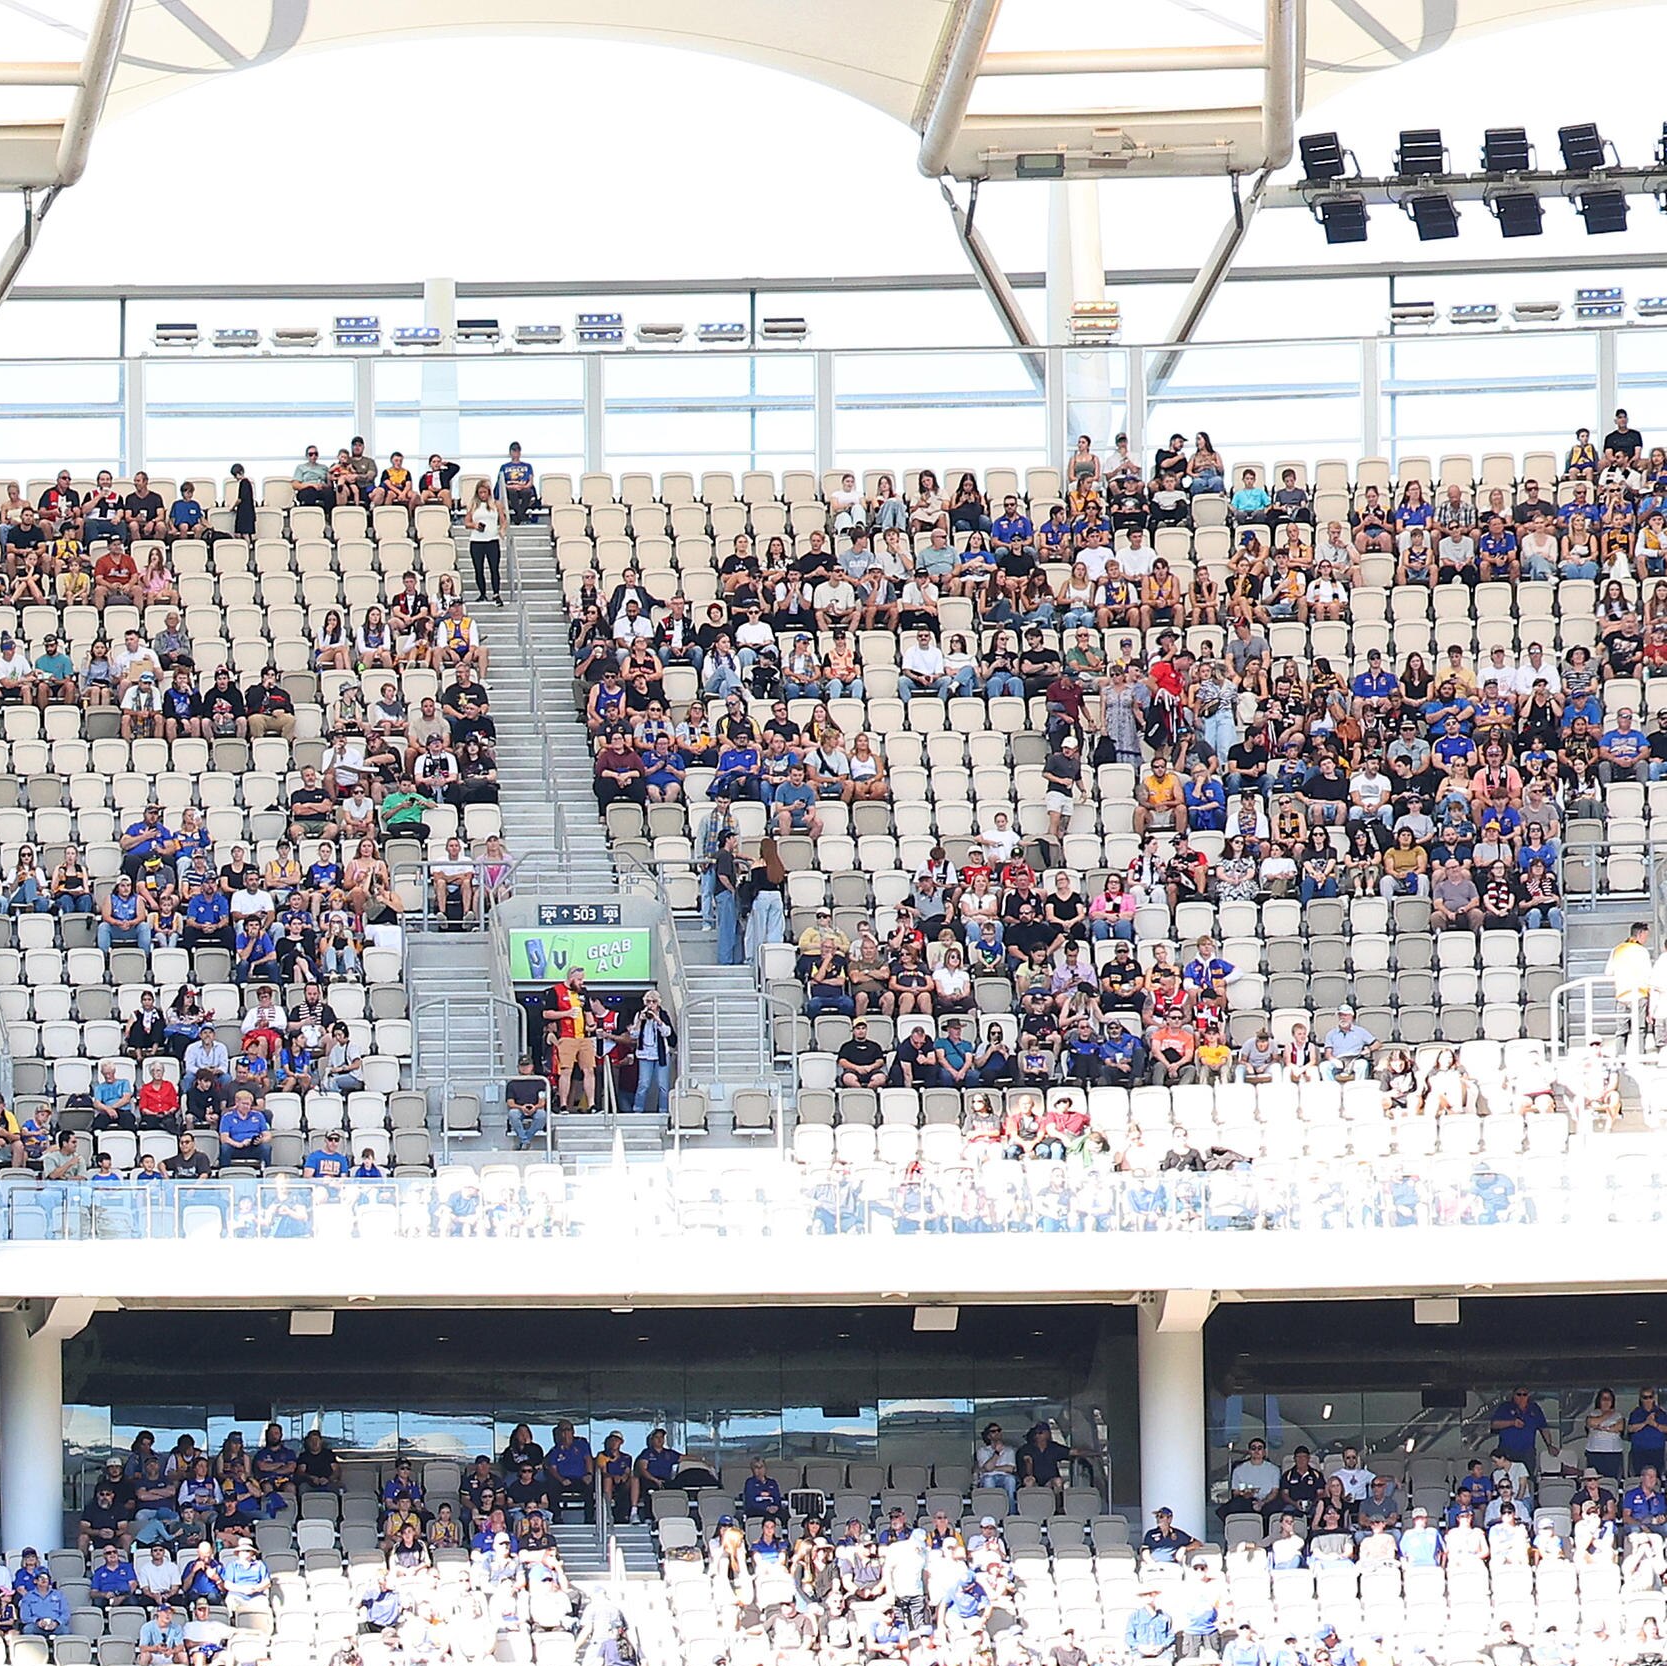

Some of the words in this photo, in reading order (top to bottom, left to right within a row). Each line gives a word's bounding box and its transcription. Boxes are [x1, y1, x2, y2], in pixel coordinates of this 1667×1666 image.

[573, 908, 597, 921] 503
[602, 909, 619, 918] 503
[587, 938, 632, 960] GRAB
[596, 958, 609, 973] A
[612, 955, 623, 969] U
